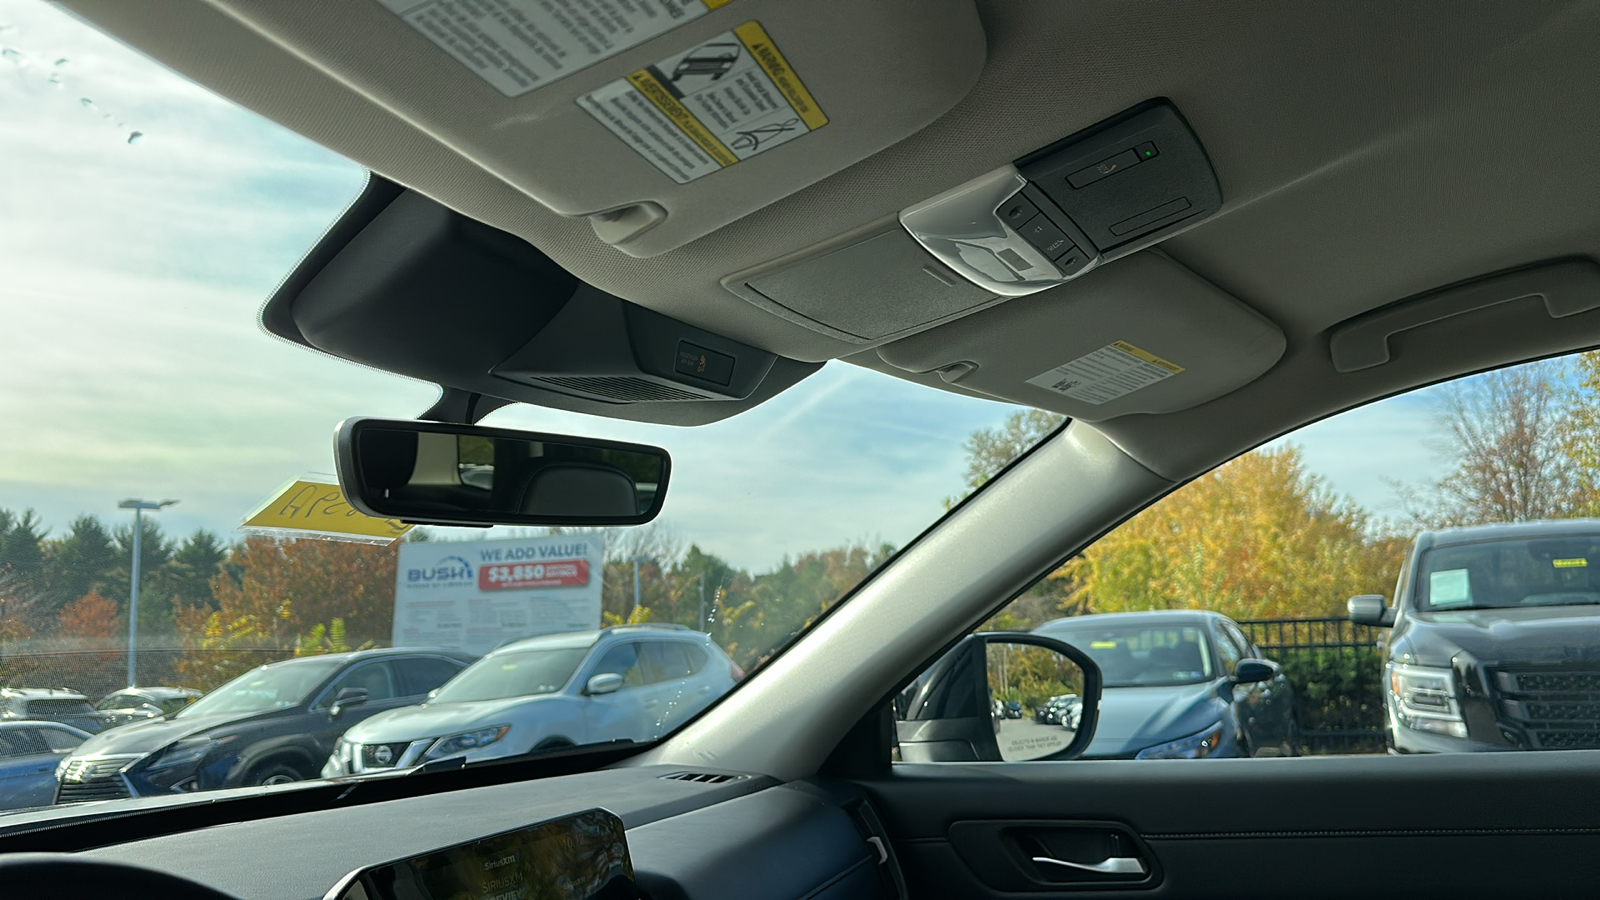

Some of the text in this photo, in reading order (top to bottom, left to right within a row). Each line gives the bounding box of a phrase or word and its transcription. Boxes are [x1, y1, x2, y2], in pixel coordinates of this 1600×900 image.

[480, 542, 588, 562] WE ADD VALUE!
[408, 566, 466, 582] BUSH
[482, 872, 523, 894] SIRIUSXM
